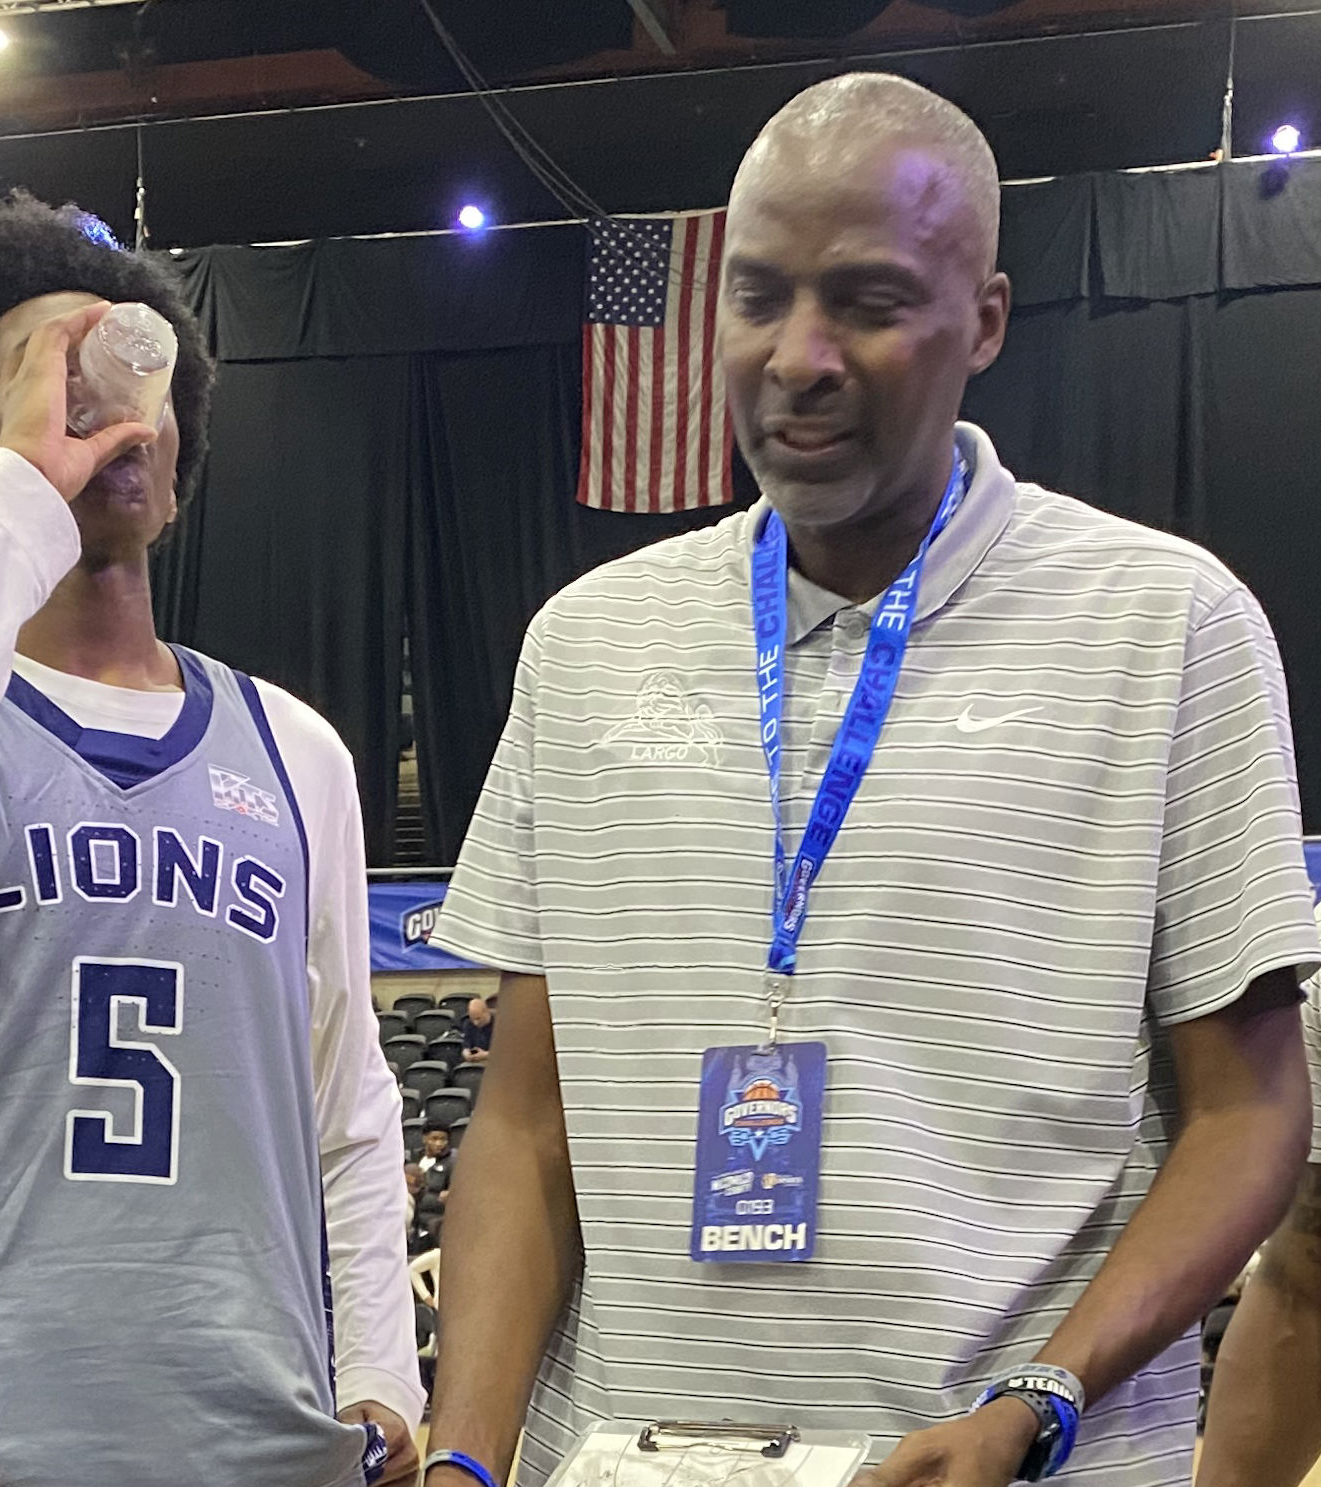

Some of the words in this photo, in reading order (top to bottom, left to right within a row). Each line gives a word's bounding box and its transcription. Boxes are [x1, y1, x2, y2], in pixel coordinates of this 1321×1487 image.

[877, 569, 918, 632] THE
[759, 645, 780, 713] THE
[631, 745, 688, 760] LARGO
[815, 641, 897, 846] CHALLENGE
[64, 956, 184, 1185] 5
[701, 1223, 807, 1252] BENCH
